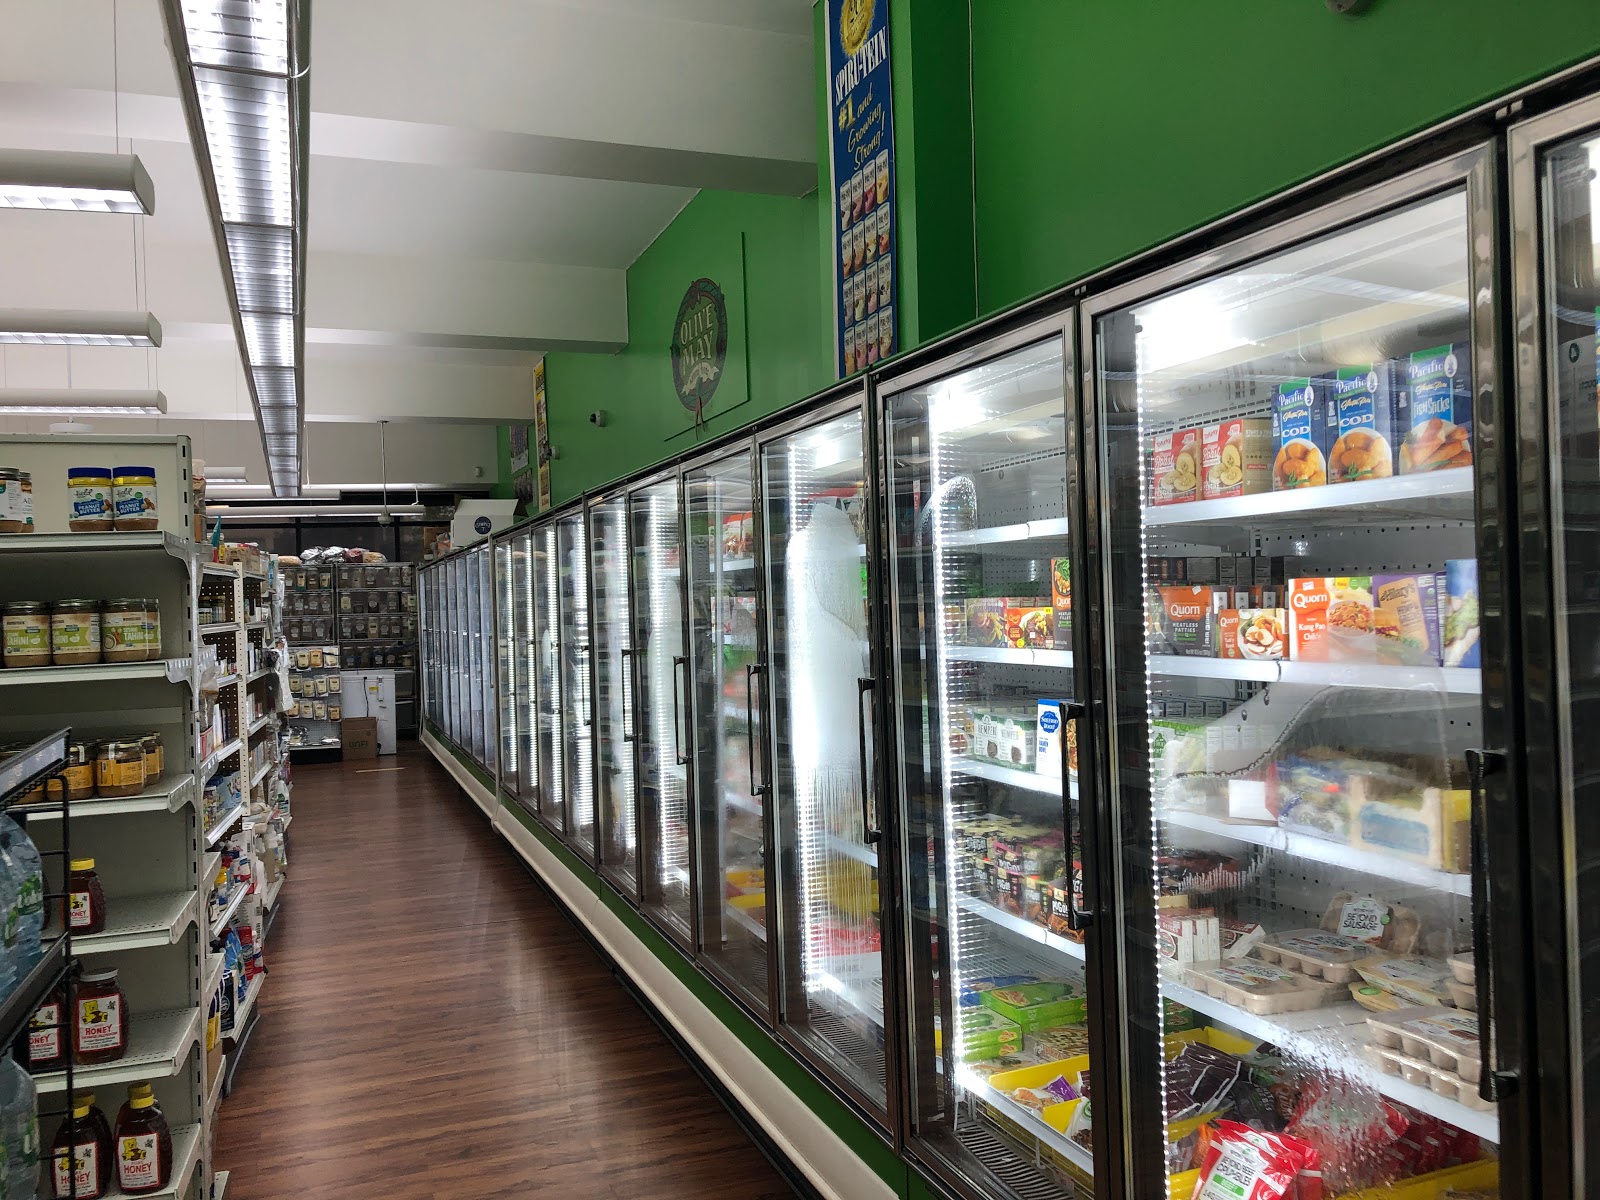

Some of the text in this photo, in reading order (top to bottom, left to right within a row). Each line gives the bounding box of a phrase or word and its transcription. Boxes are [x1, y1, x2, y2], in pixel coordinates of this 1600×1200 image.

[835, 26, 887, 106] SPIRU-TEIN
[838, 82, 873, 134] #1 and
[847, 102, 882, 153] Growing
[854, 111, 886, 171] Strong!
[680, 303, 713, 345] OLIVE
[682, 330, 713, 376] MAY
[1409, 360, 1444, 378] Pacific
[1336, 377, 1366, 394] Pacific
[1278, 390, 1305, 407] Pacific
[1340, 413, 1375, 427] COD
[1282, 426, 1311, 438] COD
[119, 502, 140, 510] PEANUT
[1294, 593, 1328, 608] Quorn
[1170, 604, 1200, 617] Quorn
[1220, 617, 1239, 627] Quorn
[70, 909, 87, 918] ONEY
[1343, 920, 1379, 931] SAUSAGE
[85, 1024, 113, 1036] HONEY
[29, 1034, 51, 1045] ONEY
[123, 1162, 152, 1174] HONEY
